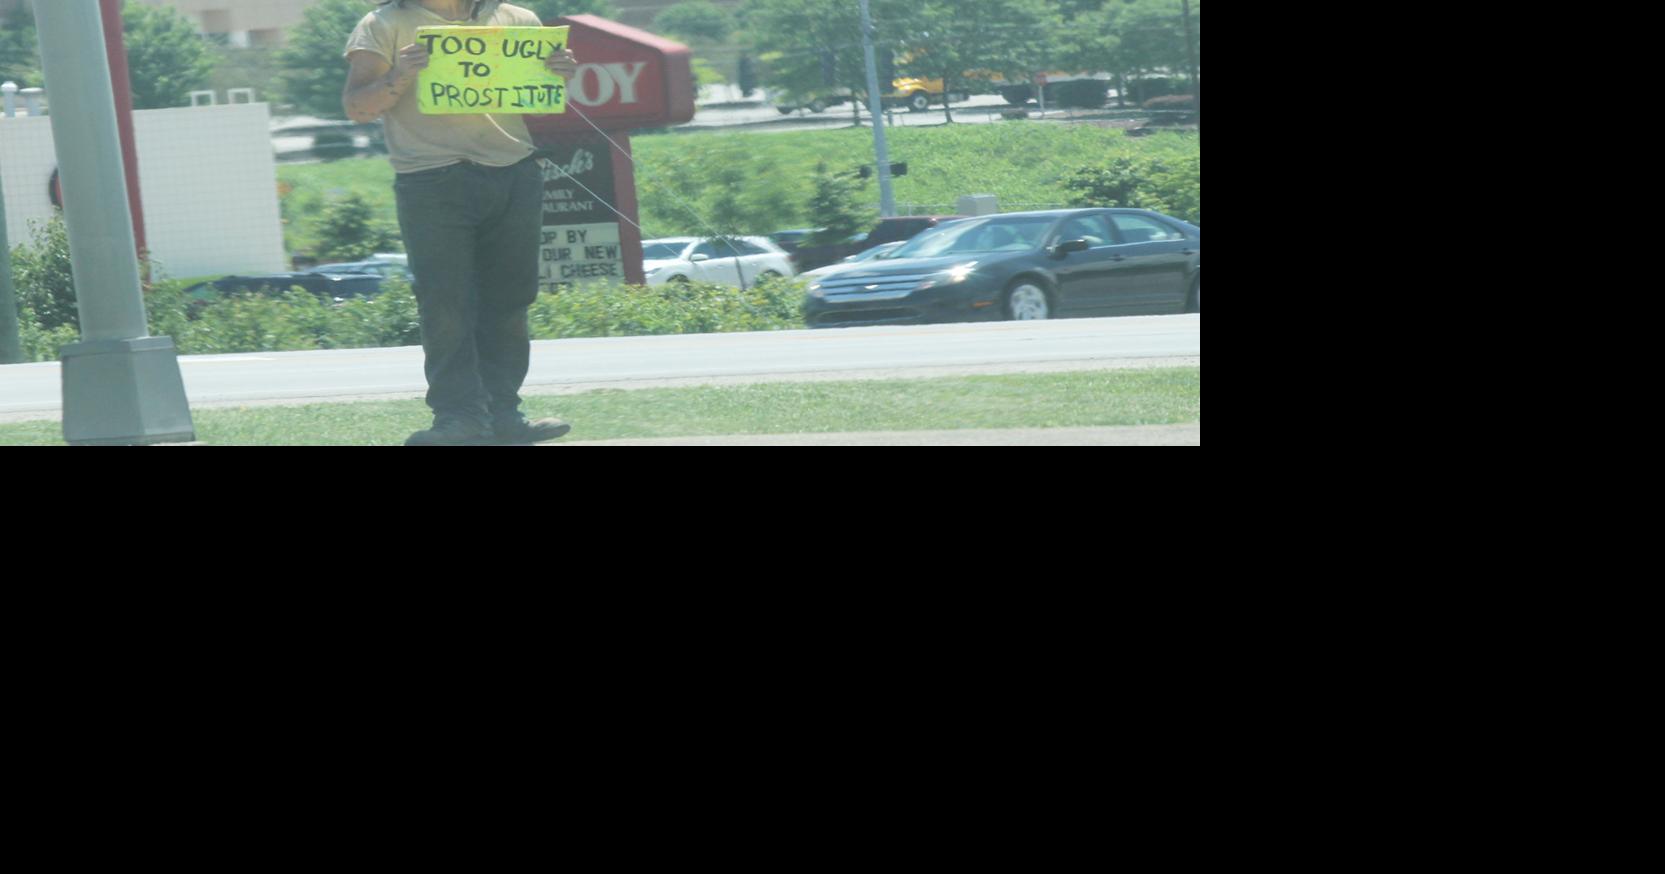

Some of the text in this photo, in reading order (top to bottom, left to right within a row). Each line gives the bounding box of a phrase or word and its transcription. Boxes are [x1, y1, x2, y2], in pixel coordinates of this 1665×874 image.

[419, 34, 563, 60] TOO UGLY
[458, 62, 490, 78] TO
[568, 62, 647, 106] OY
[430, 82, 564, 108] PROSTITUTE
[566, 229, 588, 243] BY
[584, 245, 617, 259] NEW
[560, 263, 618, 278] CHEESE
